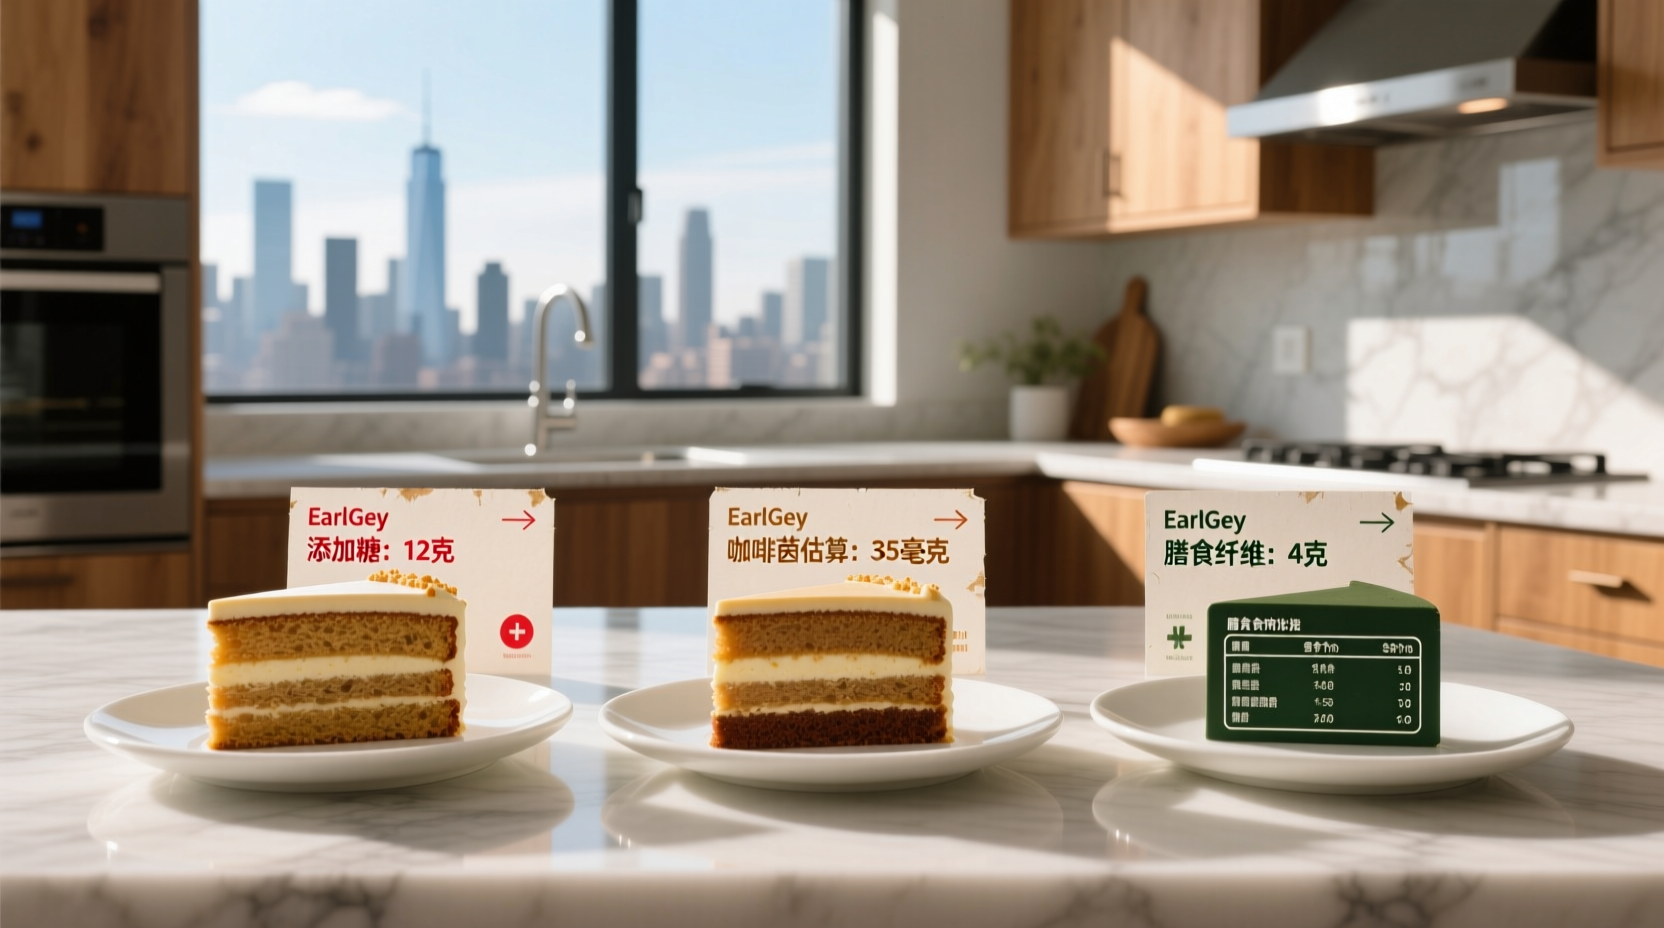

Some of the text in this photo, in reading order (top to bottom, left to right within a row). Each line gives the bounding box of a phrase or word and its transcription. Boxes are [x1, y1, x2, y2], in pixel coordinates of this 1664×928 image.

[308, 506, 389, 530] EarlGey
[728, 507, 808, 531] EarlGey
[1164, 509, 1247, 535] EarlGey
